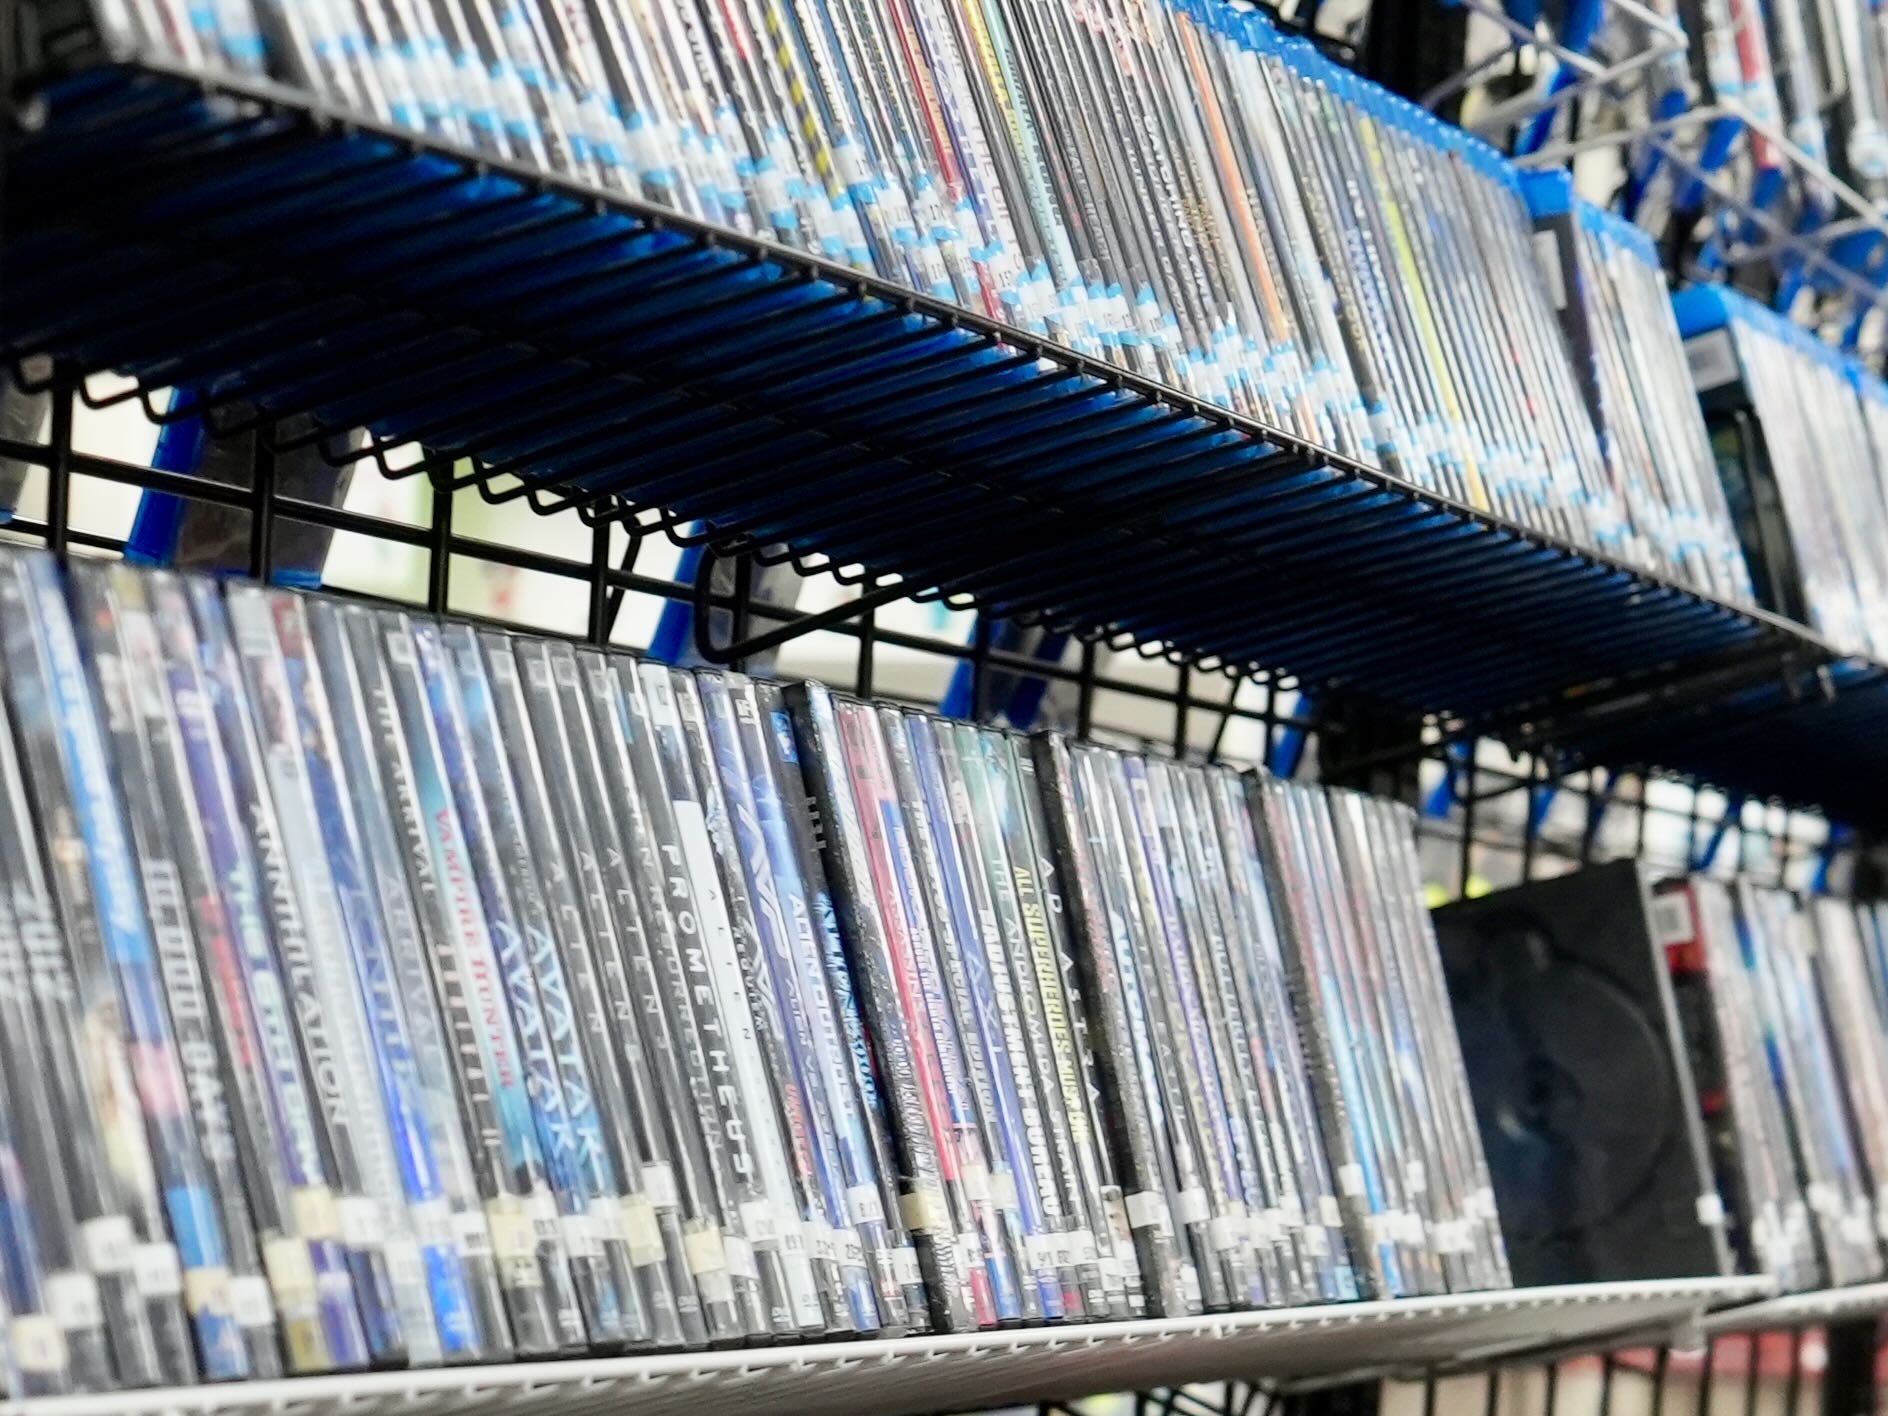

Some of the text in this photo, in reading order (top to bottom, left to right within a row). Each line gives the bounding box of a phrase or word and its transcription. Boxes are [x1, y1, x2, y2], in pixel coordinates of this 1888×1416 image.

[248, 802, 350, 1129] ANNIHILATION
[433, 808, 514, 1089] VAMPIRE HUNTER
[1012, 863, 1033, 896] ALL
[1022, 900, 1072, 1058] SUPERHEROES
[1039, 855, 1103, 1104] AD ASTRA
[492, 916, 580, 1162] AVATAR
[525, 920, 601, 1170] AVATAR
[660, 843, 752, 1178] PROMETHEUS
[1004, 916, 1055, 1094] ANDROMEDA
[1019, 1104, 1060, 1219] BUREAU
